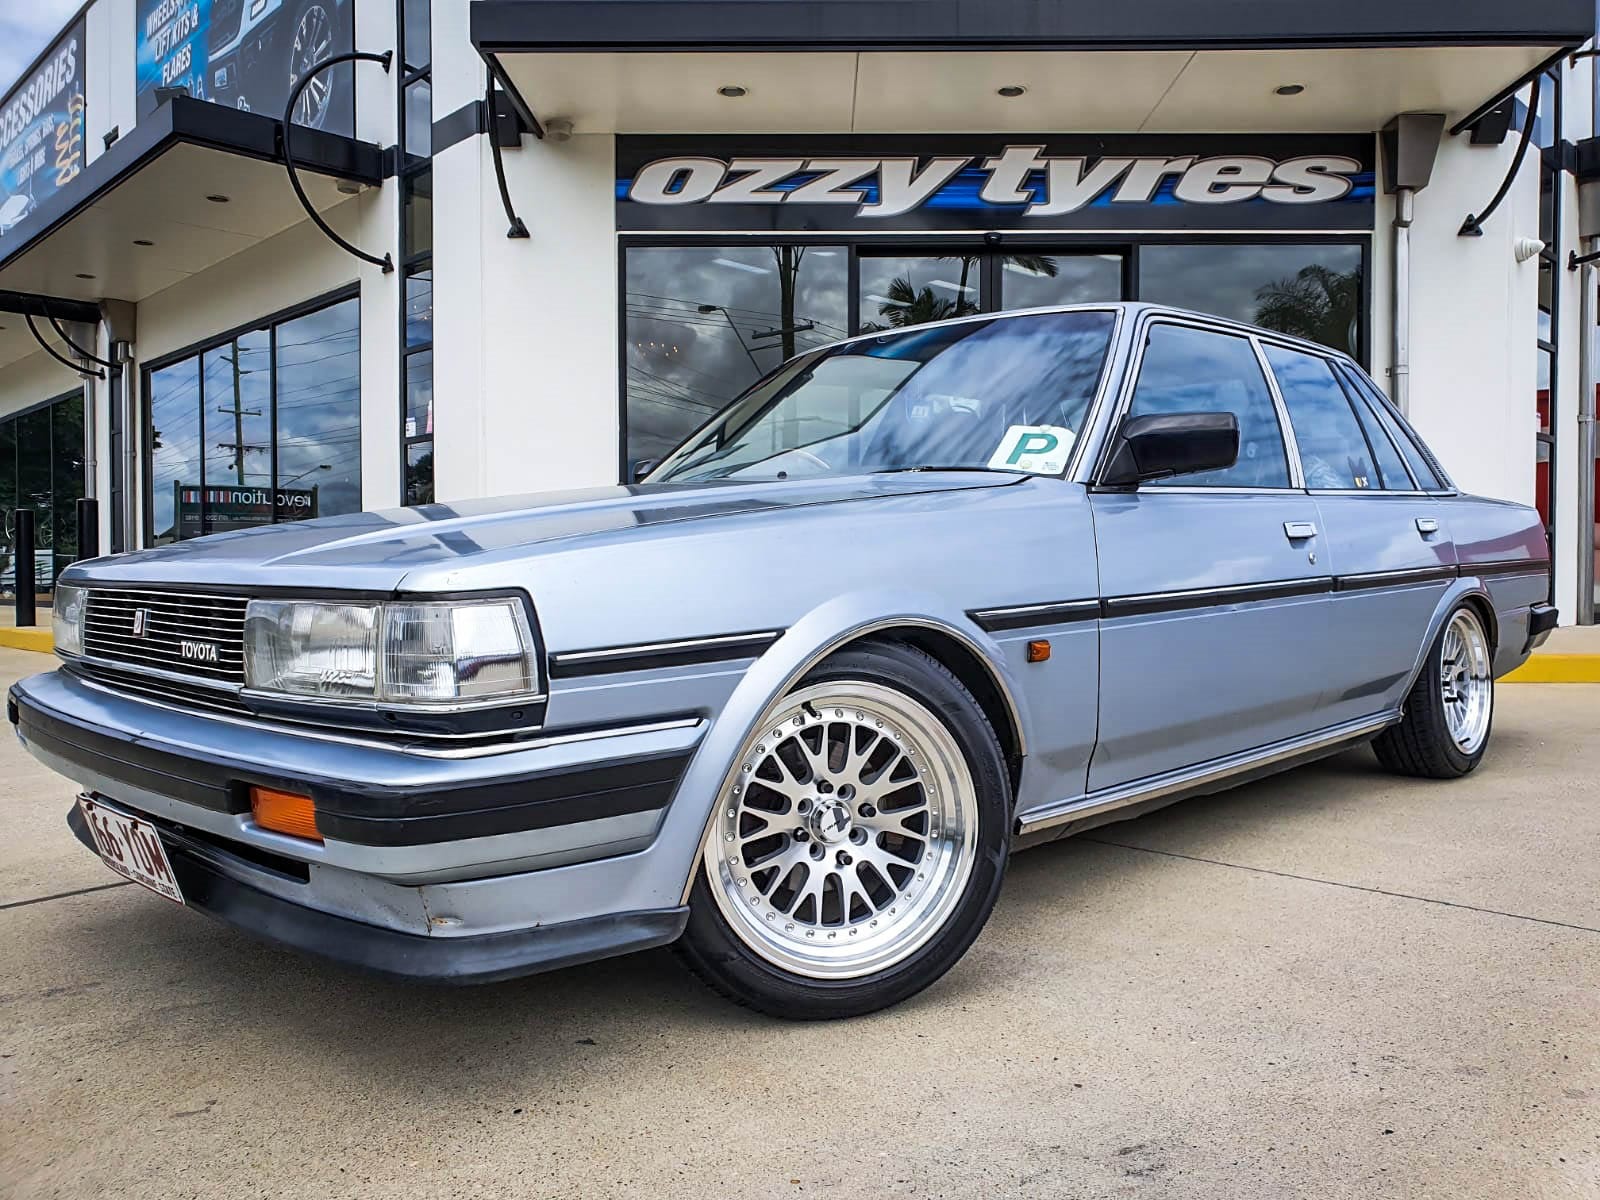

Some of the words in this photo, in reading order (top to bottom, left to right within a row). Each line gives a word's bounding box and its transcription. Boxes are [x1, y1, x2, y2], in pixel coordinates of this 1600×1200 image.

[155, 28, 172, 60] LIFT
[172, 10, 191, 47] KITS
[191, 3, 199, 28] &
[162, 43, 192, 87] FLARES
[628, 156, 975, 218] ozzy
[979, 143, 1362, 217] tyres
[1006, 433, 1059, 465] P
[180, 641, 217, 661] TOYOTA
